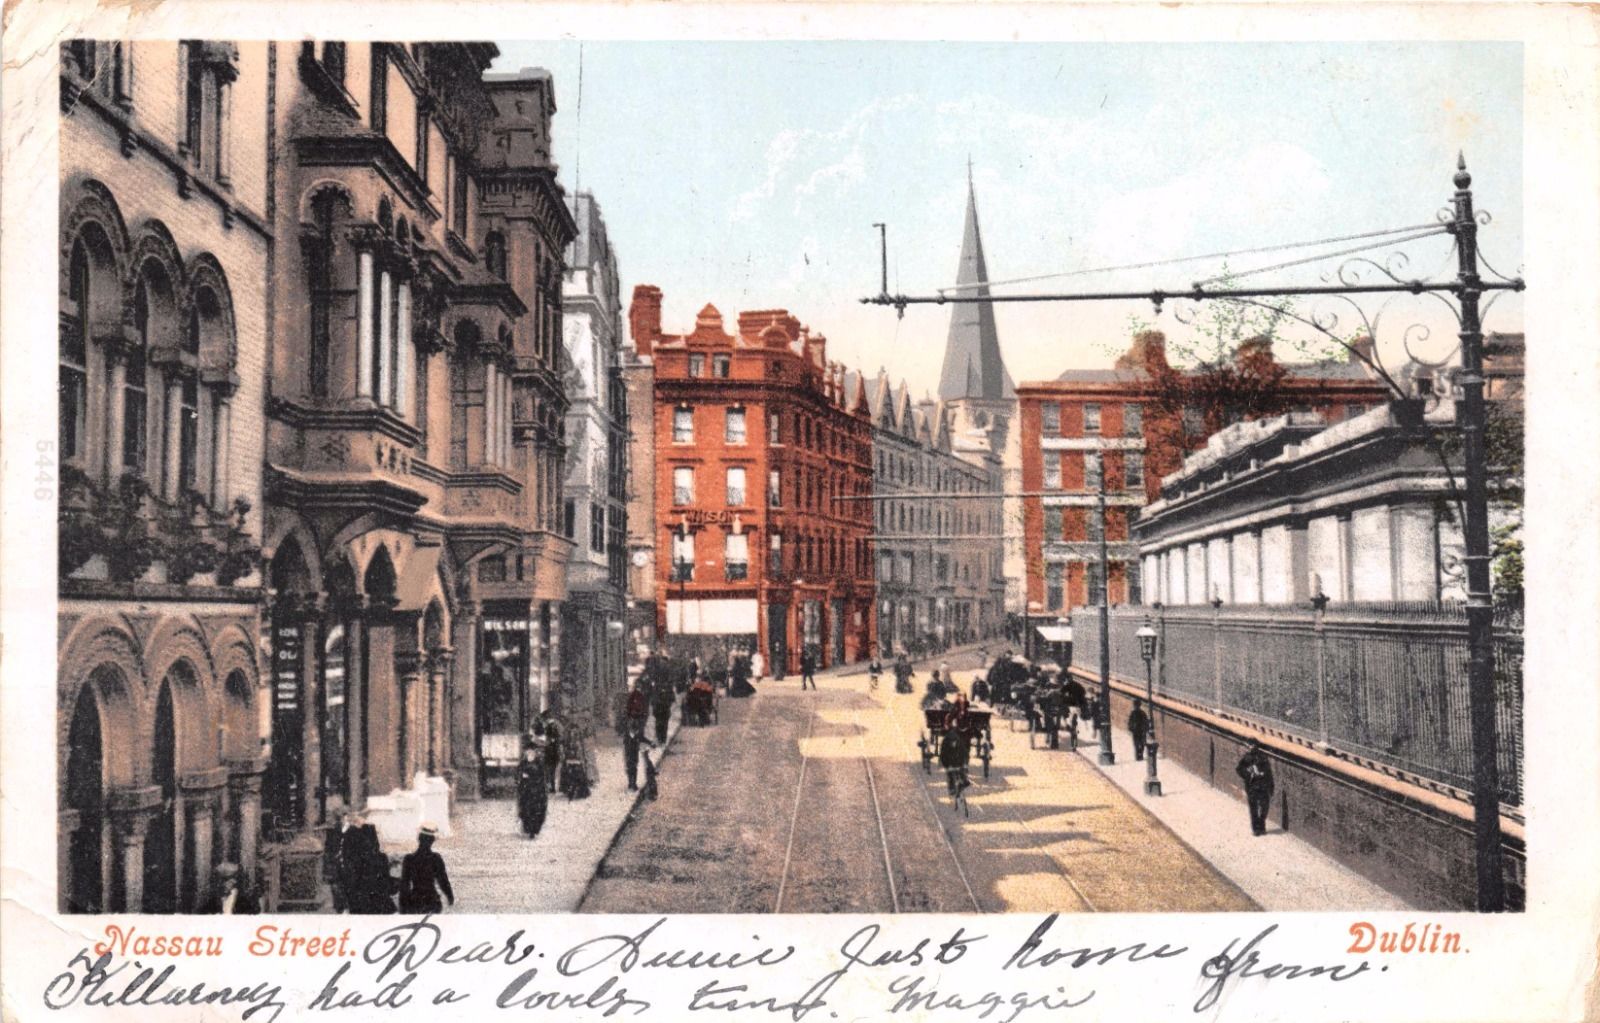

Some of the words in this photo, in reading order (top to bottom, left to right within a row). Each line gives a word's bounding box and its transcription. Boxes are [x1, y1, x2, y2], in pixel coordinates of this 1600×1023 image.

[1002, 912, 1189, 970] home
[43, 947, 286, 1023] Killarney
[308, 961, 418, 1012] had
[432, 987, 470, 1006] a
[496, 967, 651, 1018] lovely
